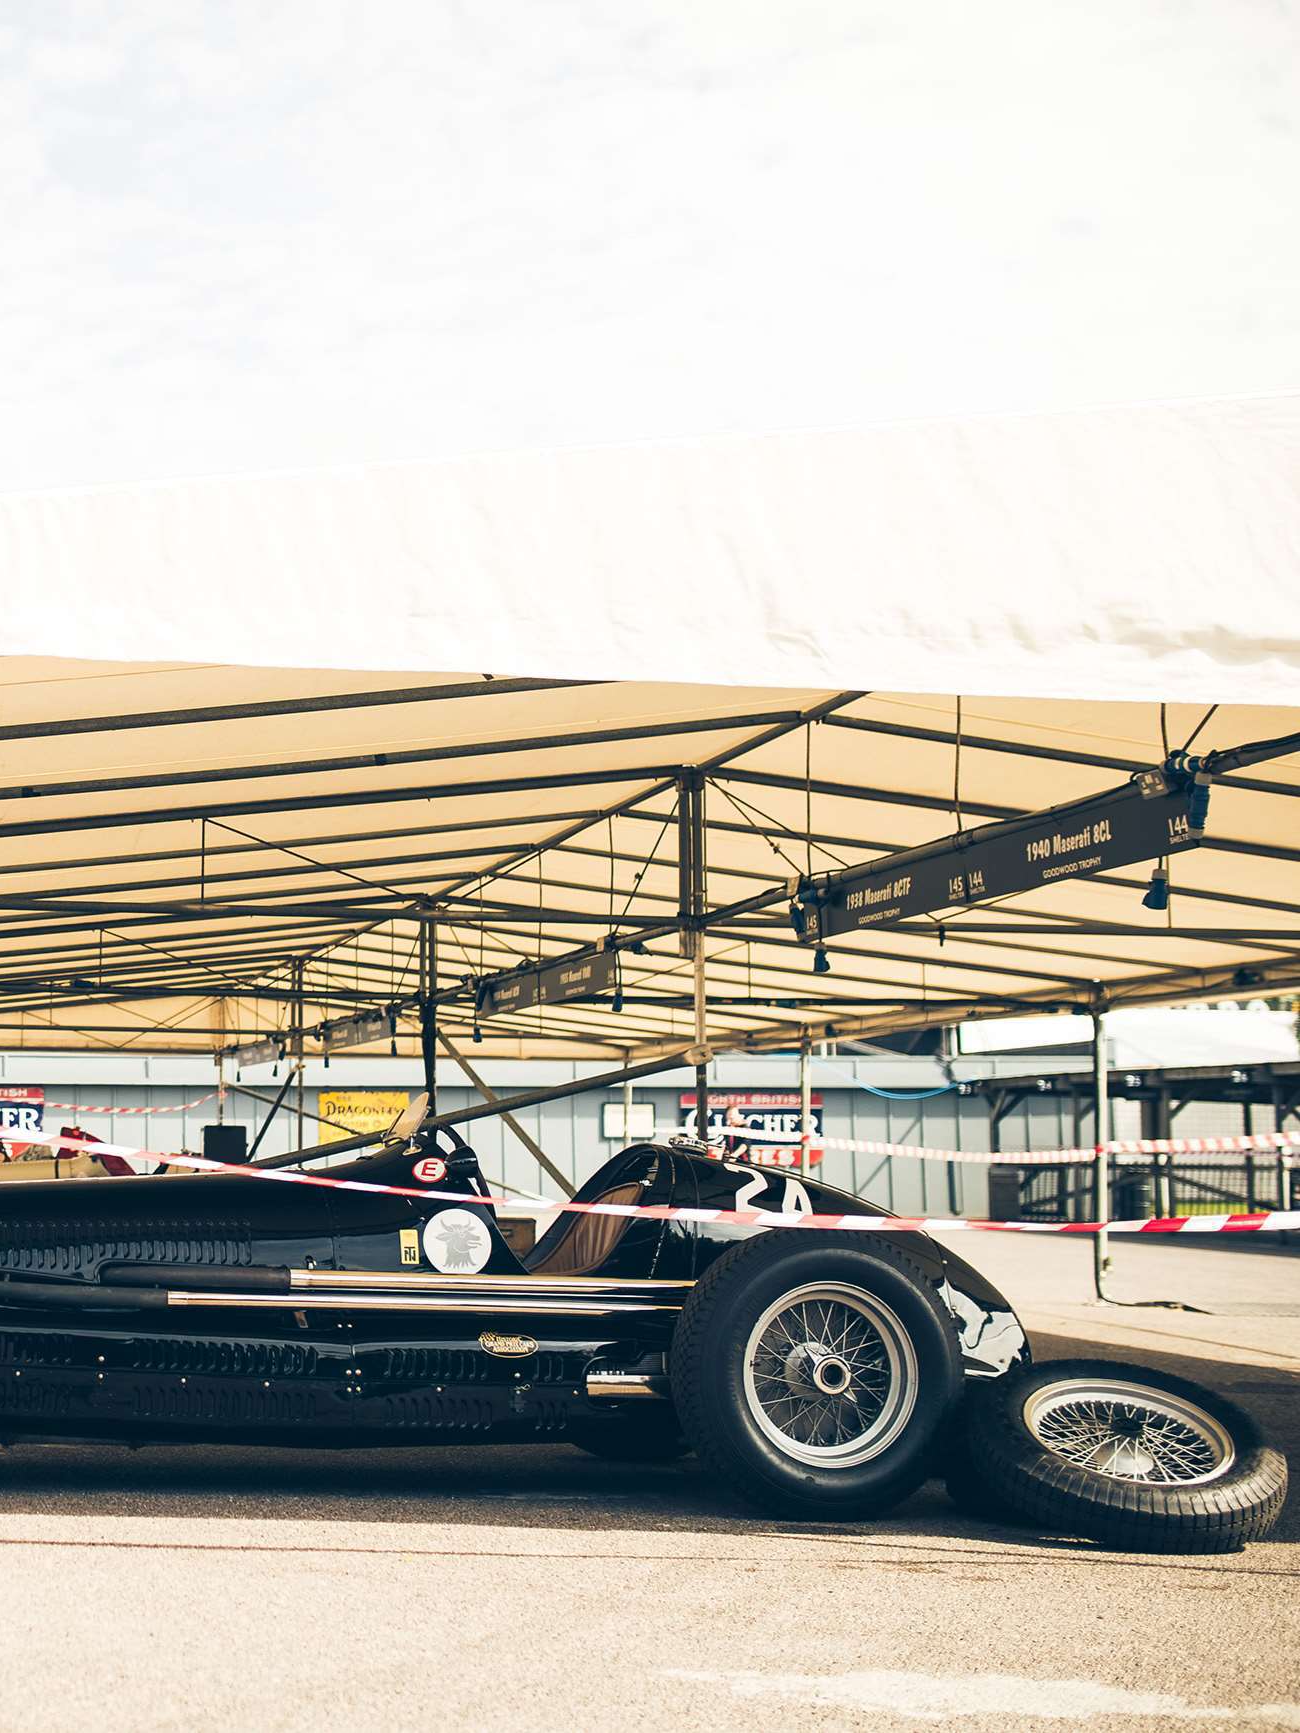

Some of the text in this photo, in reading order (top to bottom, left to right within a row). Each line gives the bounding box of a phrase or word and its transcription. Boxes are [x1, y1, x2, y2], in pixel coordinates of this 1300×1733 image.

[1168, 814, 1189, 837] 144
[1026, 819, 1112, 862] 1940 Maserati 8CL
[1169, 834, 1190, 845] SHELTE
[1042, 856, 1102, 879] GOODWOOD TROPHY
[949, 876, 964, 894] 145
[968, 870, 984, 888] 144
[865, 882, 892, 905] Maserati
[893, 877, 912, 898] 8CTF
[806, 914, 818, 930] 145
[707, 1094, 803, 1106] ORTH BRITIS
[421, 1162, 438, 1177] E
